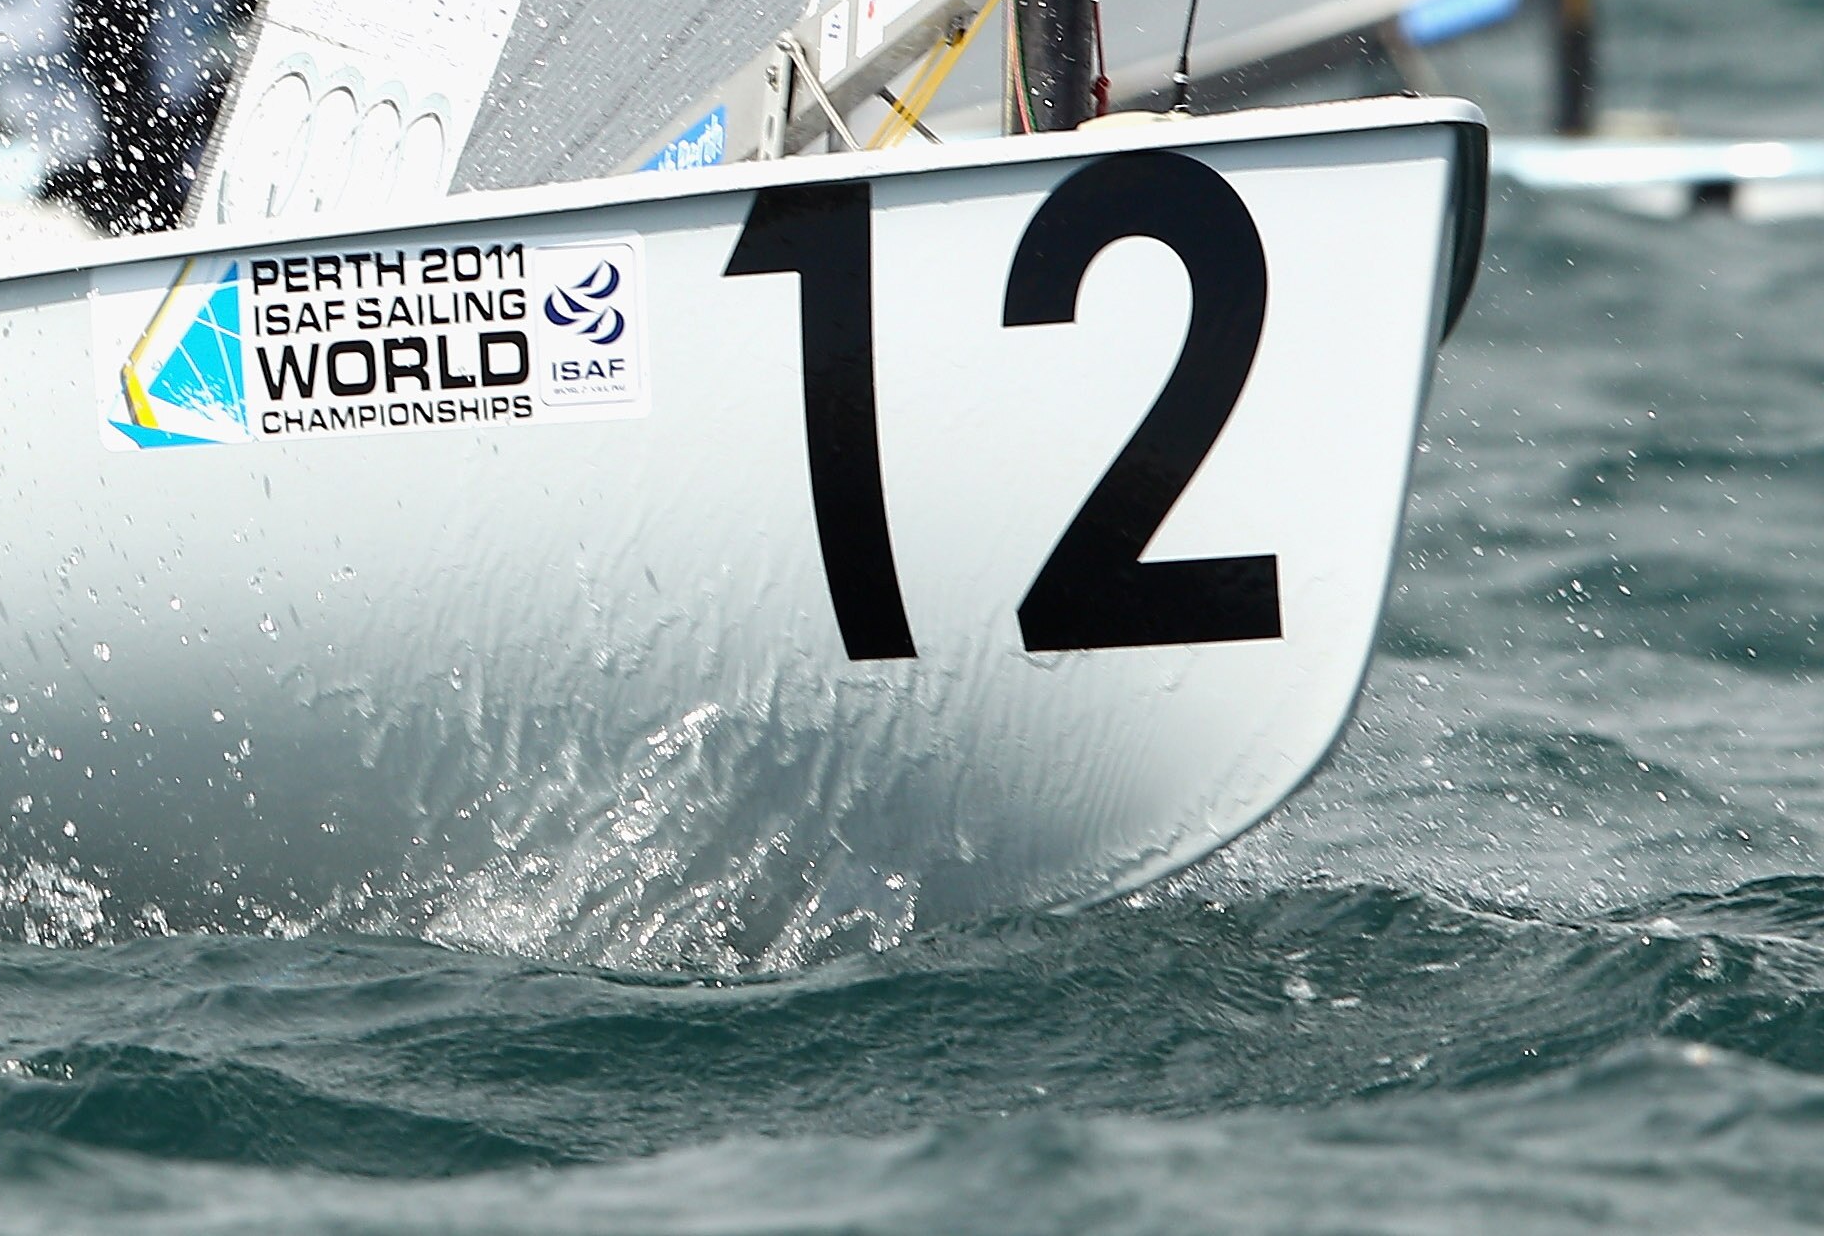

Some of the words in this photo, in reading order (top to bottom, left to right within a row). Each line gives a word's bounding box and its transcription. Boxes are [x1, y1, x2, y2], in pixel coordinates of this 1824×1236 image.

[251, 251, 406, 295] PERTH
[422, 243, 527, 285] 2011
[254, 301, 347, 336] ISAF
[358, 288, 528, 330] SAILING
[256, 330, 531, 400] WORLD
[551, 358, 625, 381] ISAF
[261, 394, 534, 435] CHAMPIONSHIPS
[721, 150, 1284, 661] 12
